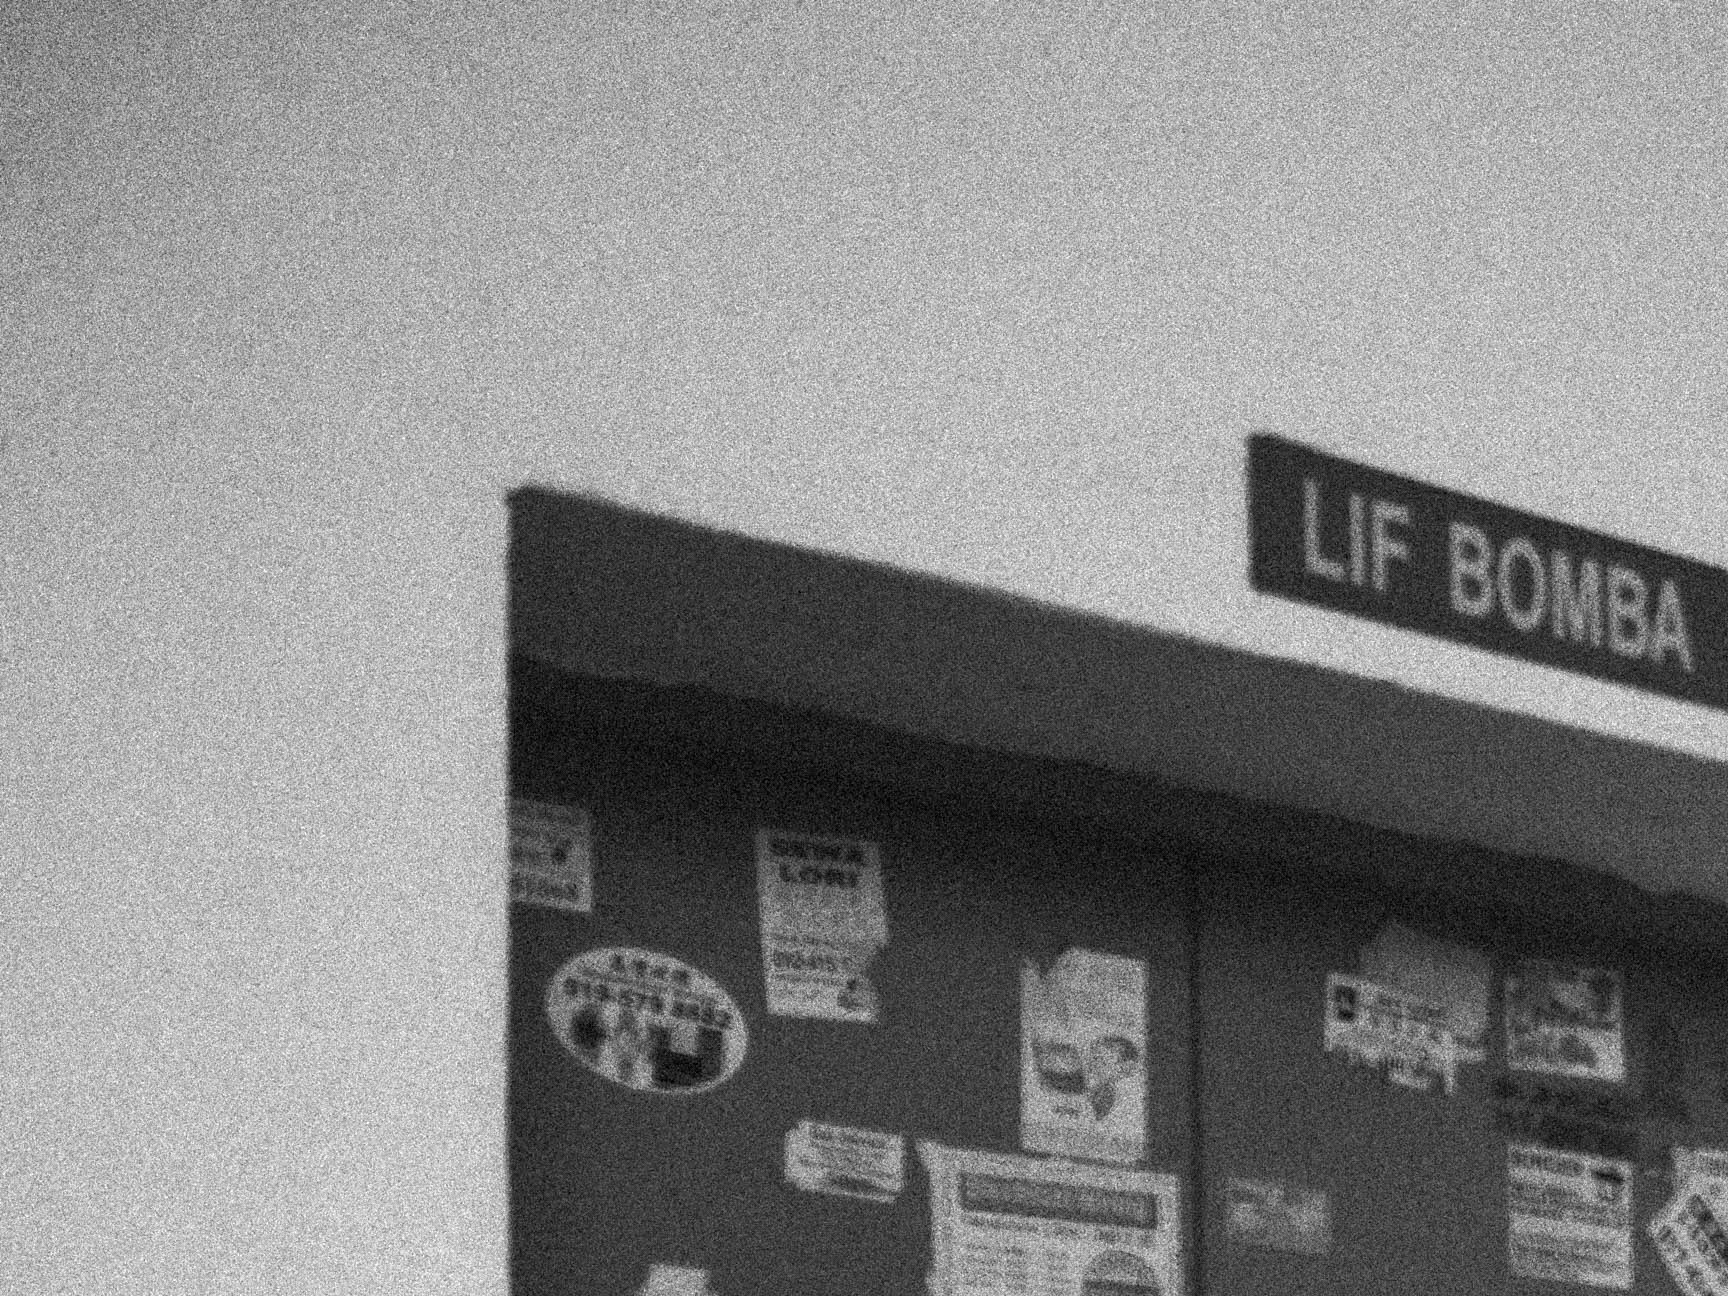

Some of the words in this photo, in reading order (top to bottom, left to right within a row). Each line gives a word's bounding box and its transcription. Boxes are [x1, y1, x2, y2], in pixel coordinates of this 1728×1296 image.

[1302, 477, 1414, 593] LIF
[1448, 520, 1696, 673] BOMBA
[779, 863, 859, 889] LORI
